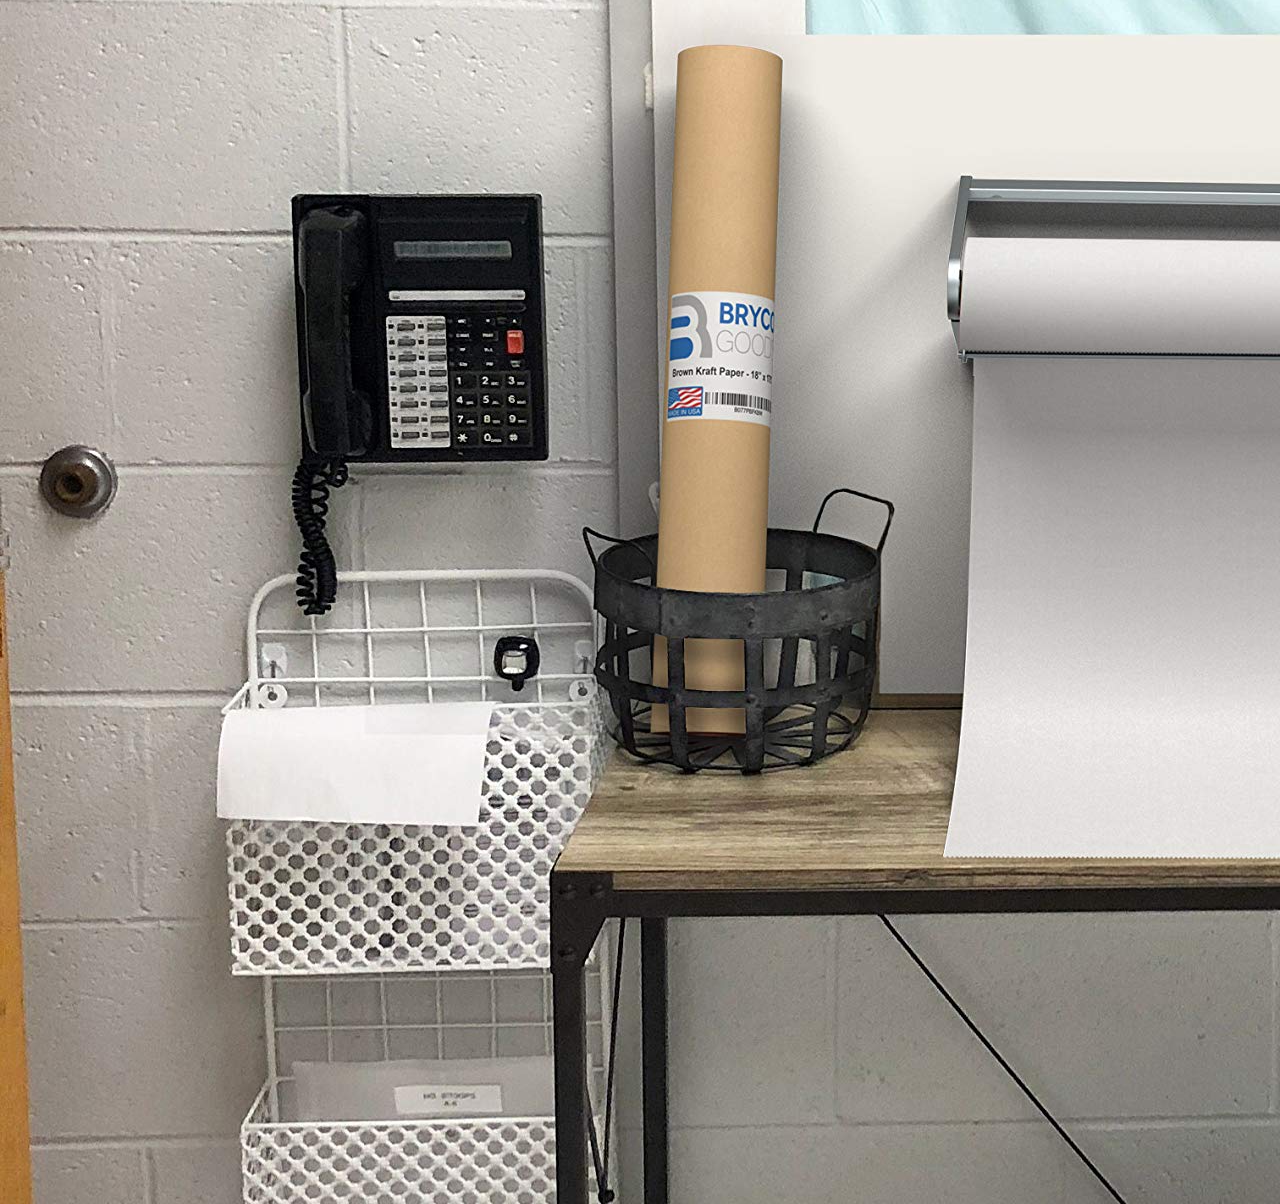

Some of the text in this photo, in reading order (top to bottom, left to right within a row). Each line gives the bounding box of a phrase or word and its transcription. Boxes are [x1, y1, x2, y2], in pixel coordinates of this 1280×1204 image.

[672, 368, 694, 377] Brown
[696, 367, 717, 375] Kraft
[719, 368, 745, 378] Paper
[482, 376, 489, 385] 2
[508, 376, 515, 385] 3
[456, 396, 463, 404] 4
[483, 395, 489, 404] 5
[508, 395, 515, 404] 6
[457, 415, 464, 423] 7
[484, 415, 490, 423] 8
[509, 415, 516, 423] 9
